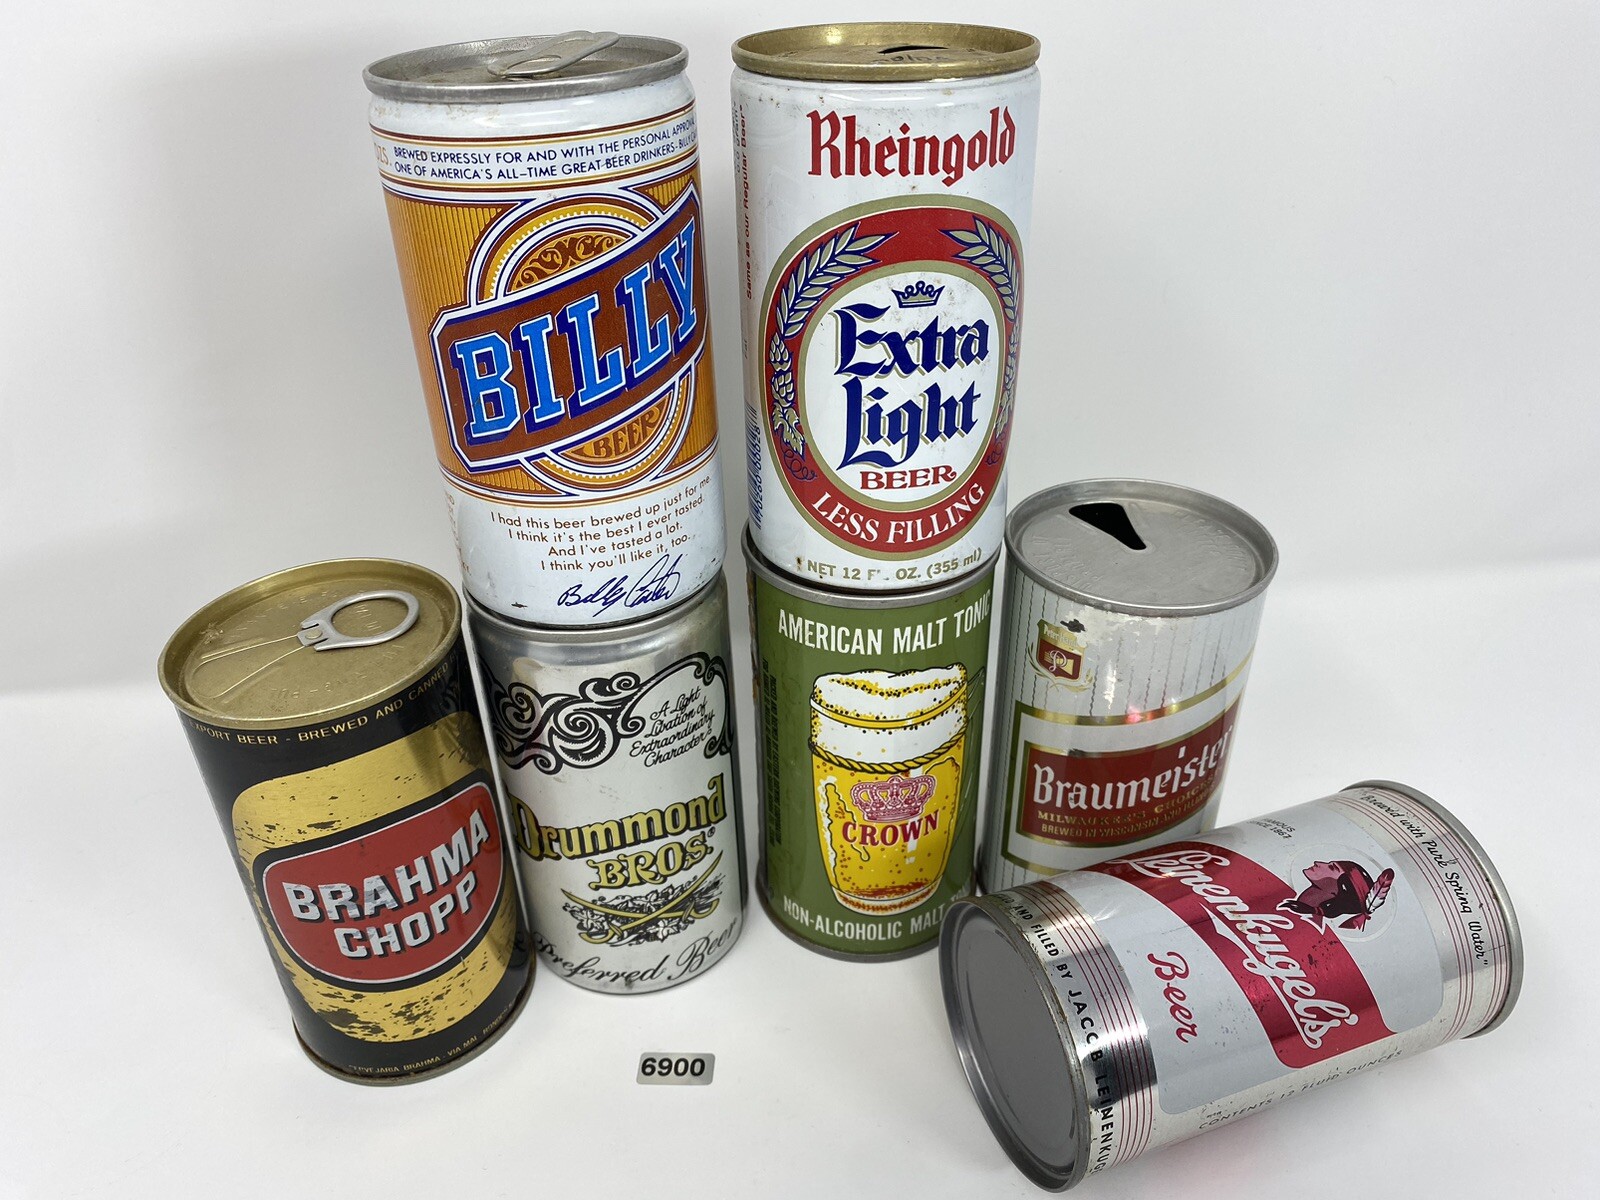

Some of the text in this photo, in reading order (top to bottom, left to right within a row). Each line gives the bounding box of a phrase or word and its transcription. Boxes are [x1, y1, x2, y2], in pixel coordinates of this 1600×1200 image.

[394, 146, 427, 162] BREWED
[431, 151, 491, 164] EXPRESSLY
[496, 152, 522, 163] FOR
[526, 149, 557, 162] AND
[561, 145, 594, 159] WITH
[600, 141, 620, 154] THE
[623, 129, 671, 150] PERSONAL
[394, 162, 412, 175] ONE
[414, 165, 427, 176] OF
[431, 168, 493, 180] AMERICA'S
[605, 154, 631, 169] BEER
[806, 105, 1016, 187] Rheingold
[742, 152, 750, 210] Regular
[745, 241, 751, 256] as
[743, 264, 752, 300] Same
[449, 214, 699, 447] BILLY
[827, 302, 990, 379] Extra
[592, 406, 661, 459] BEER
[835, 376, 982, 471] Light
[859, 464, 957, 490] BEER
[491, 511, 495, 522] I
[498, 514, 521, 528] had
[526, 517, 550, 529] this
[554, 517, 585, 529] beer
[590, 506, 642, 527] brewed
[645, 504, 660, 516] up
[662, 493, 682, 512] just
[685, 485, 698, 503] for
[508, 496, 705, 543] I think it's the best I ever tasted.
[811, 482, 985, 545] LESS FILLING
[541, 534, 691, 572] I think you'll like it, too.
[548, 521, 683, 557] And I've tasted a lot.
[807, 547, 983, 581] NET 12 F. OZ. (355 ml)
[778, 589, 991, 655] AMERICAN MALT TONIC
[237, 734, 278, 745] BEER
[298, 715, 368, 742] BREWED
[375, 699, 403, 719] AND
[408, 662, 449, 700] CANNED
[644, 695, 708, 738] Libation of
[650, 686, 701, 720] A Light
[629, 709, 715, 757] Extraordinary
[1033, 724, 1233, 810] Braumeister
[508, 772, 727, 862] Drummond
[842, 809, 939, 847] CROWN
[1041, 824, 1082, 837] BREWED
[282, 808, 491, 924] BRAHMA
[1400, 818, 1426, 839] with
[1422, 839, 1449, 869] Pure
[1444, 872, 1473, 914] Spring
[333, 870, 478, 961] CHOPP
[783, 896, 946, 941] NON-ALCOHOLIC MALT
[1013, 905, 1033, 920] AND
[1031, 924, 1059, 957] FILLED
[1056, 963, 1073, 979] BY
[533, 917, 738, 984] Preferred Beer
[1105, 850, 1359, 1049] Leinenkugel's
[1147, 951, 1197, 1044] Beer
[403, 1056, 441, 1071] BRAHMA
[447, 1046, 461, 1057] VIA
[641, 1057, 706, 1077] 6900
[1199, 1049, 1403, 1129] CONTENTS 12 FLUID OUNCES
